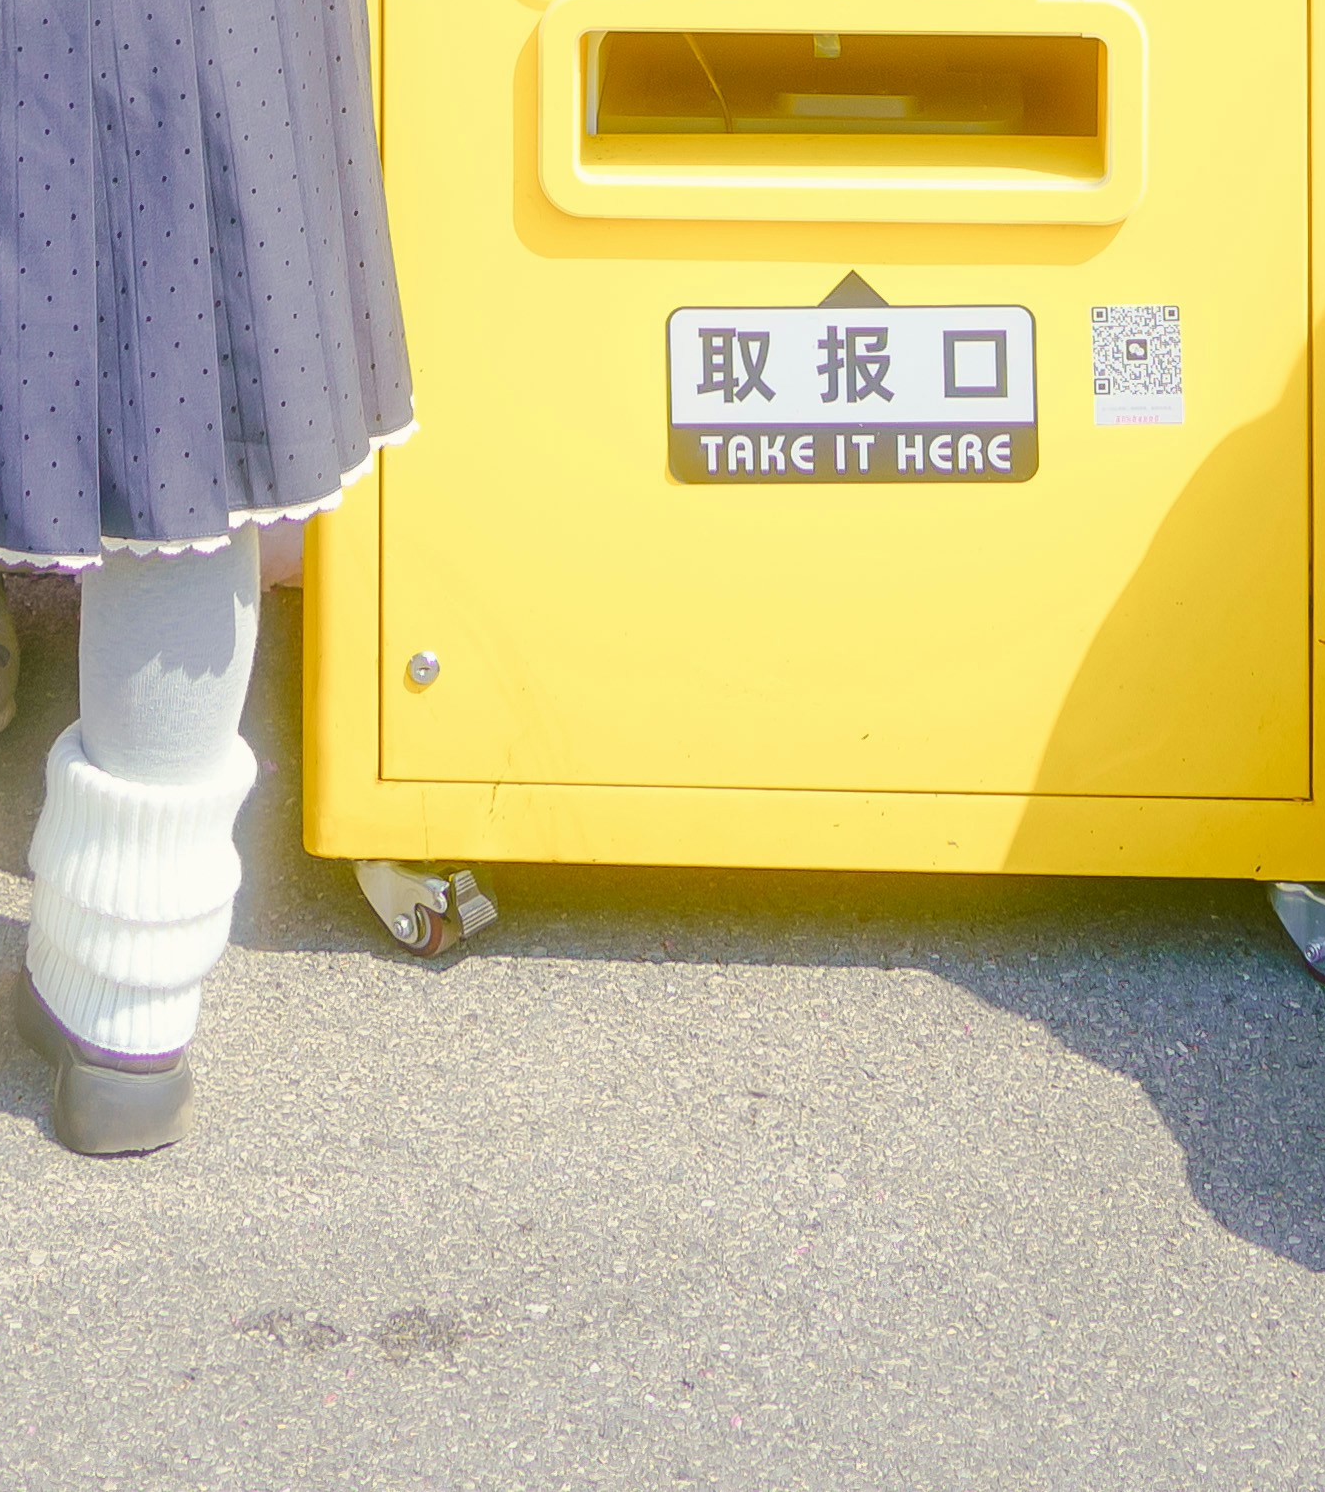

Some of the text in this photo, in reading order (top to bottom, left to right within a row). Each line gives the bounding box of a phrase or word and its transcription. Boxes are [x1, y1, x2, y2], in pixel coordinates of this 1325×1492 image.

[695, 325, 1009, 404] 取报口
[699, 433, 1012, 474] TAKE IT HERE
